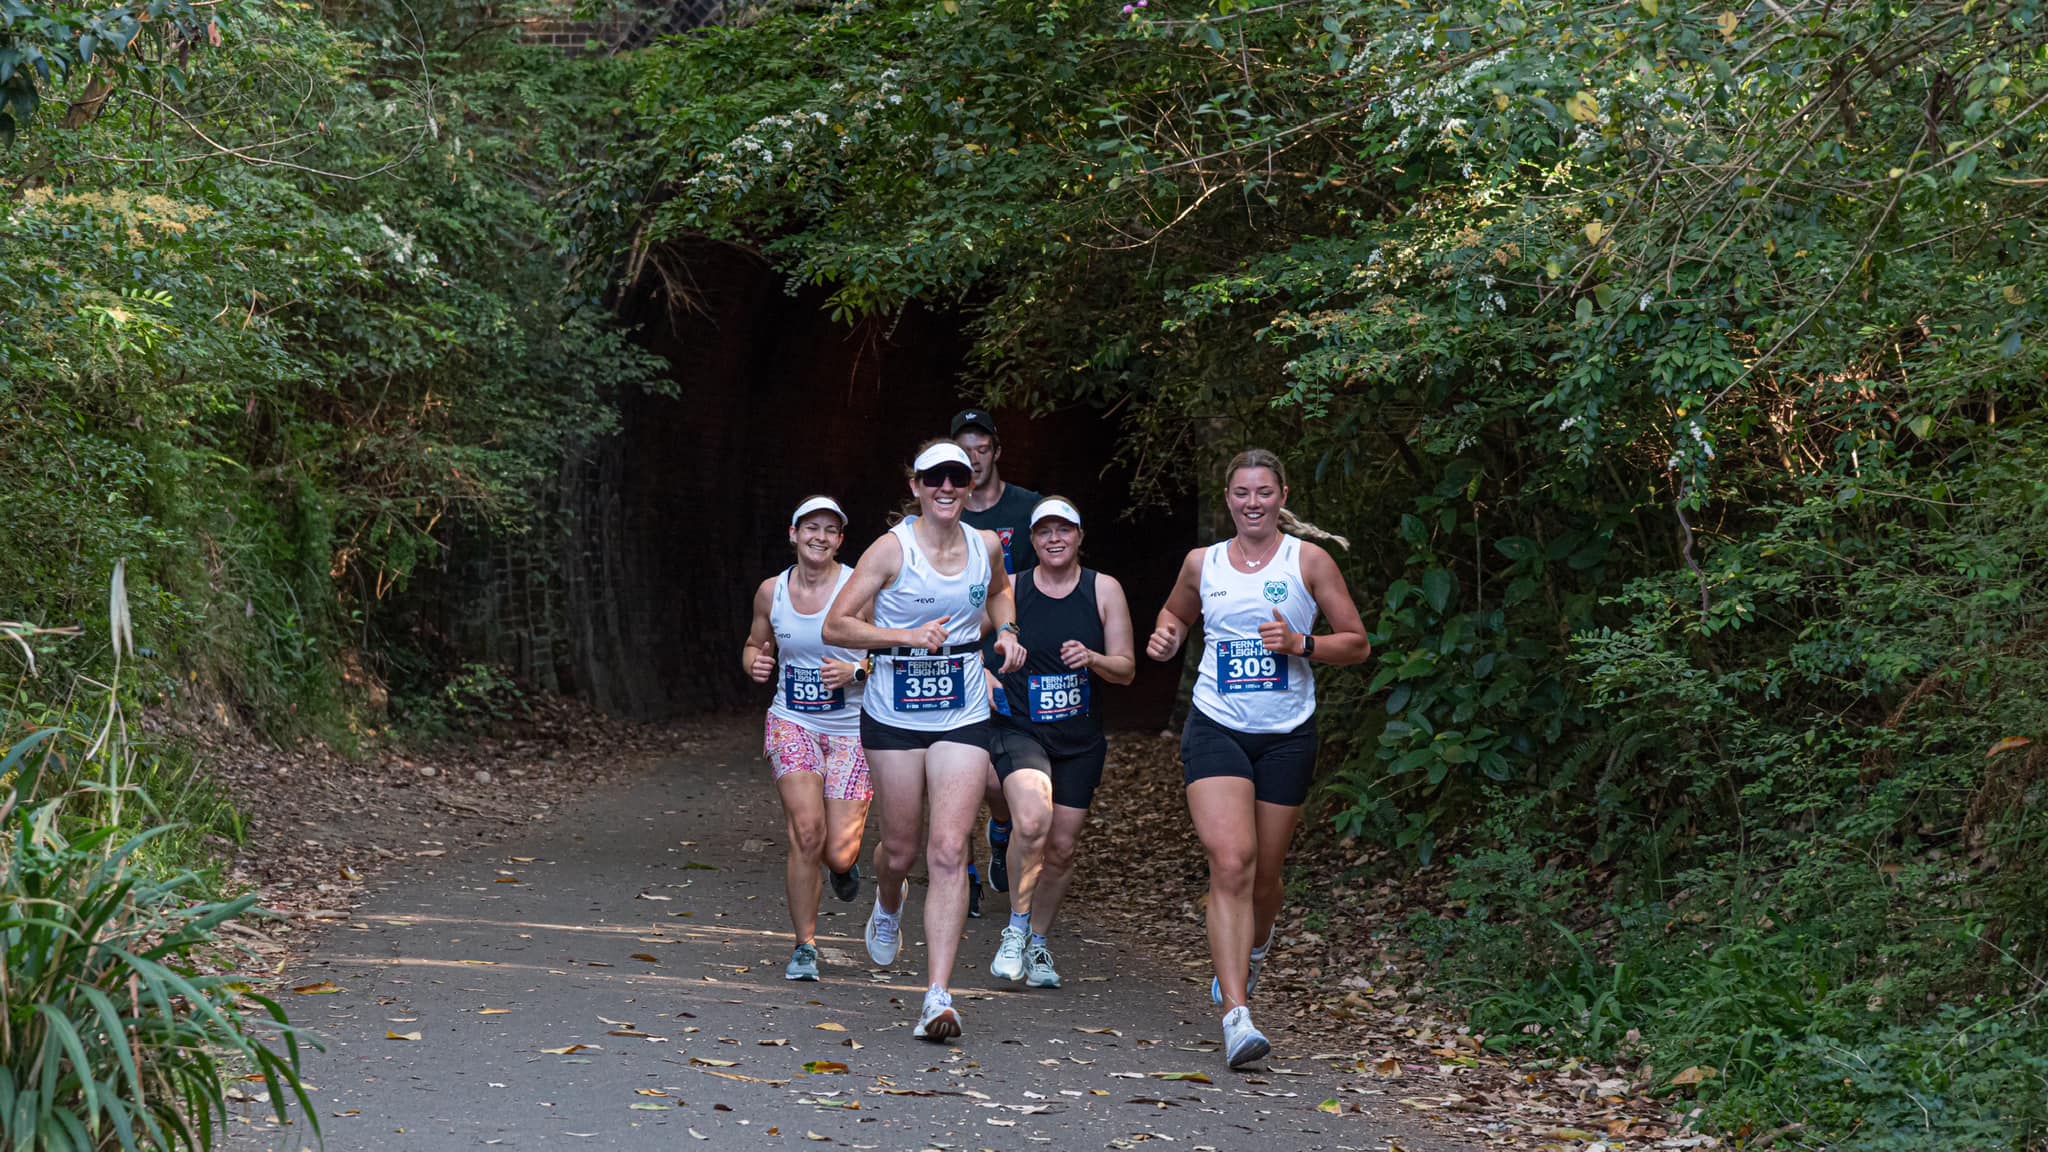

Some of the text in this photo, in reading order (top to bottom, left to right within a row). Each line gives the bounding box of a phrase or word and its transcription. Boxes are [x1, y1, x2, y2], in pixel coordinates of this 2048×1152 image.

[1230, 640, 1254, 650] FERN
[1230, 648, 1258, 657] LEIGH
[908, 661, 932, 669] FERN
[933, 660, 950, 676] 15
[1228, 657, 1276, 678] 309
[908, 668, 936, 676] LEIGH
[1041, 675, 1063, 684] FERN
[1064, 674, 1078, 688] 15
[793, 683, 833, 700] 595
[905, 676, 953, 697] 359
[1041, 682, 1066, 690] LEIGH
[1040, 688, 1081, 710] 596
